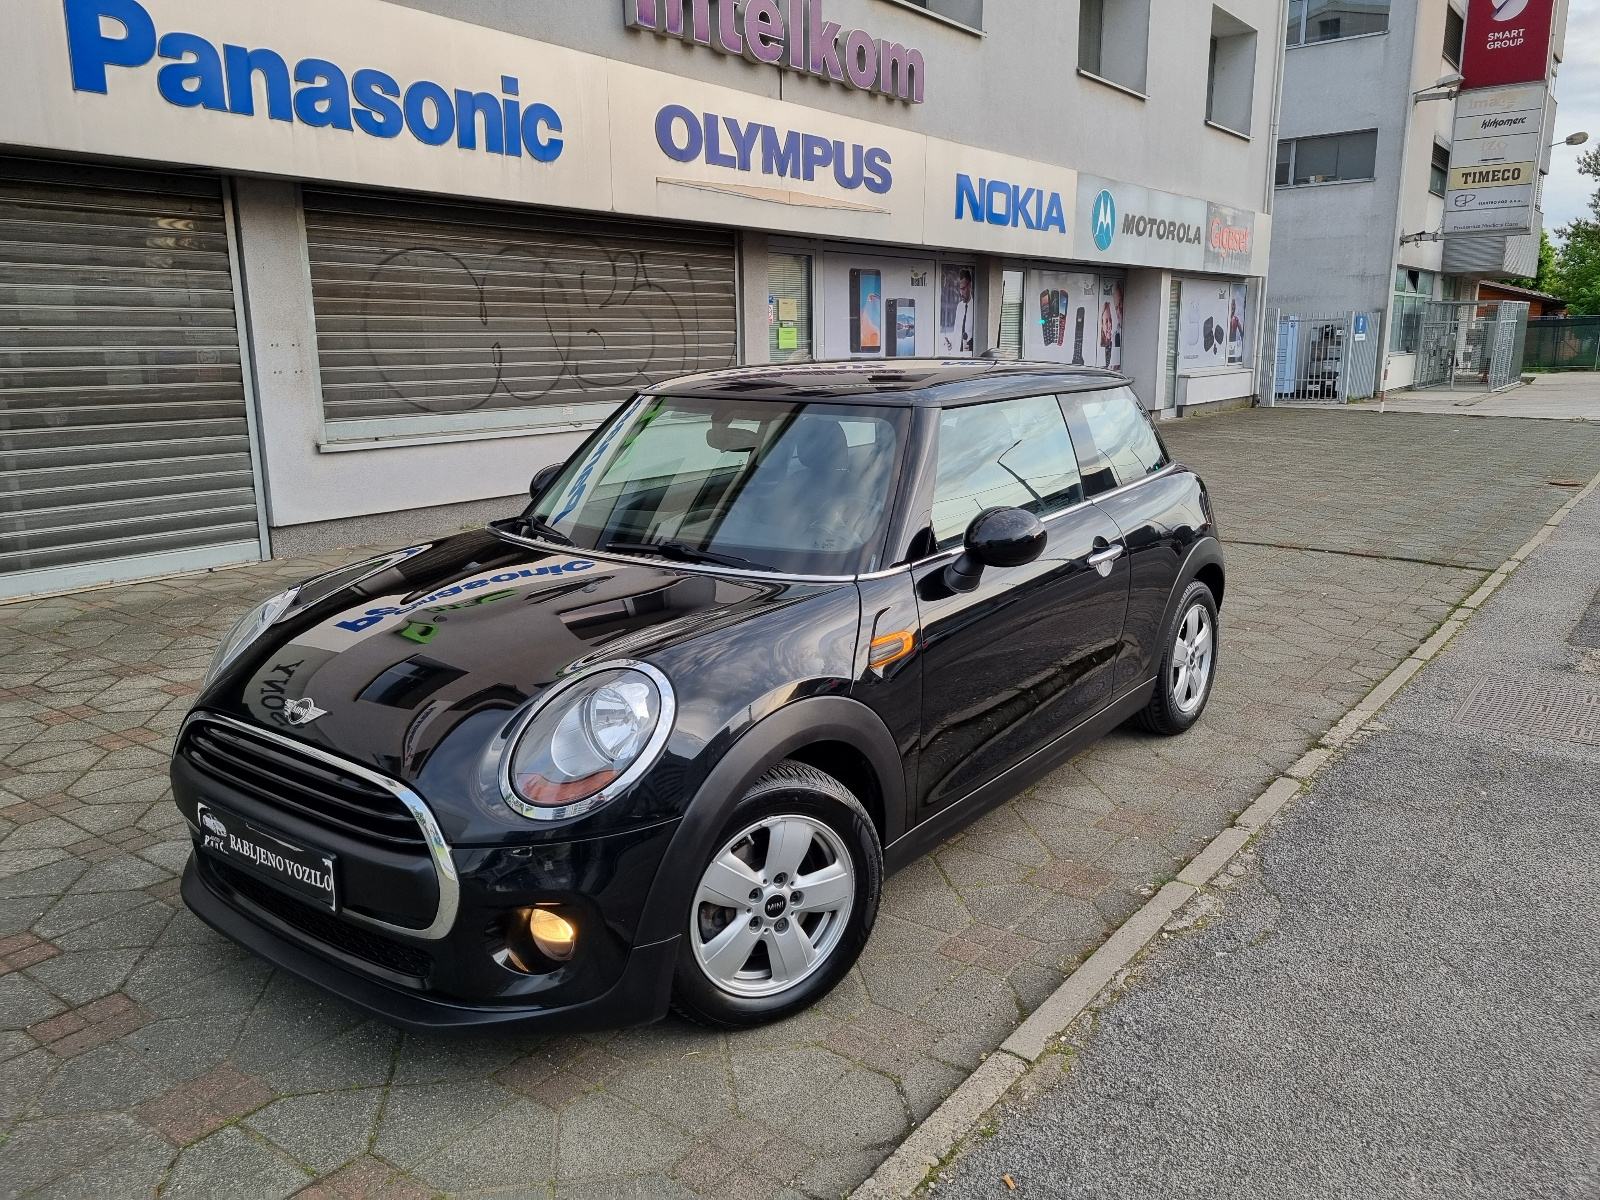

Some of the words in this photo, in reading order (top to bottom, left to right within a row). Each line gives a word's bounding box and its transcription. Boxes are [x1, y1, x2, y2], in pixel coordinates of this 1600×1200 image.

[1486, 38, 1524, 50] GROUP
[1487, 28, 1526, 41] SMART
[62, 0, 563, 163] Panasonic
[1481, 116, 1527, 129] kirkomerc
[655, 104, 893, 194] OLYMPUS
[1461, 167, 1521, 185] TIMECO
[954, 173, 1066, 234] NOKIA
[1122, 213, 1201, 245] MOTOROLA
[229, 834, 284, 872] RABLJENO
[285, 859, 332, 891] VOZILO
[767, 900, 784, 911] MINI
